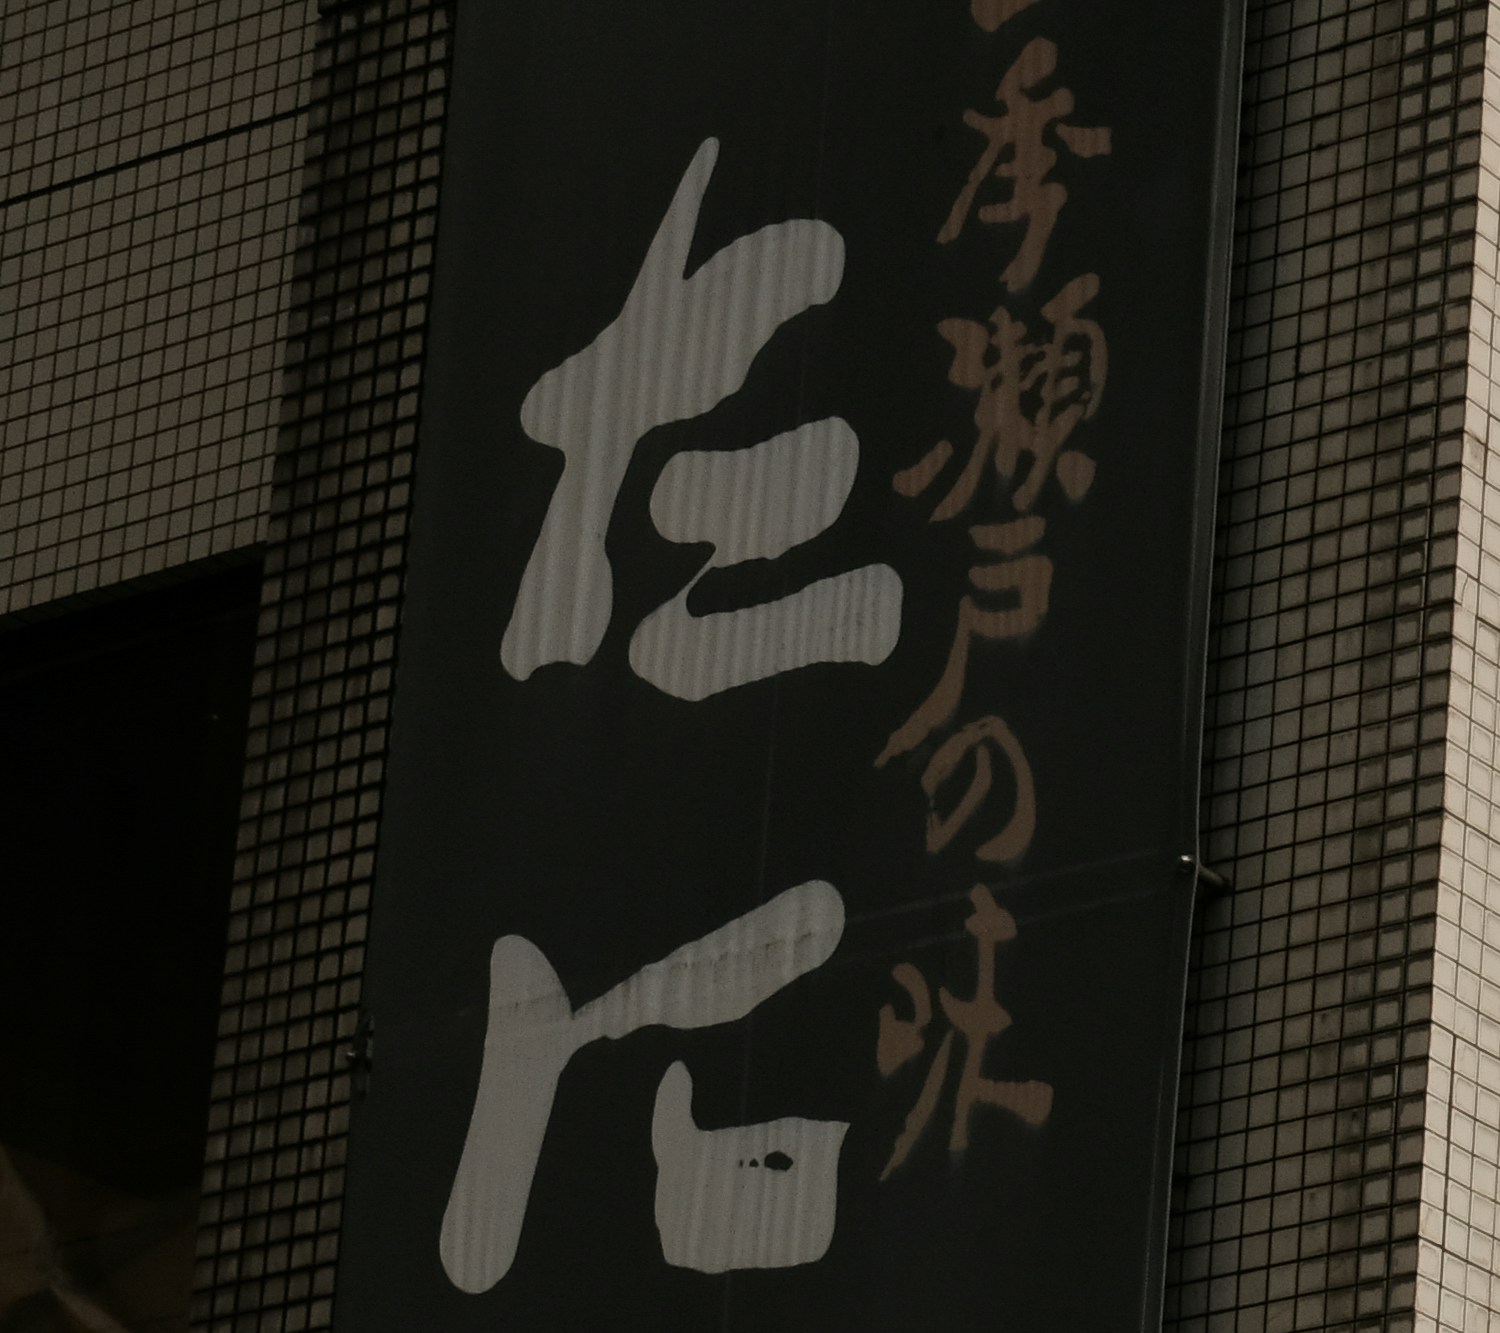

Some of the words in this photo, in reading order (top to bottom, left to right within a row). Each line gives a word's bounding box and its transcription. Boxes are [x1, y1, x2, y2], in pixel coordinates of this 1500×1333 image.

[872, 0, 1113, 1184] 季瀬戸の味
